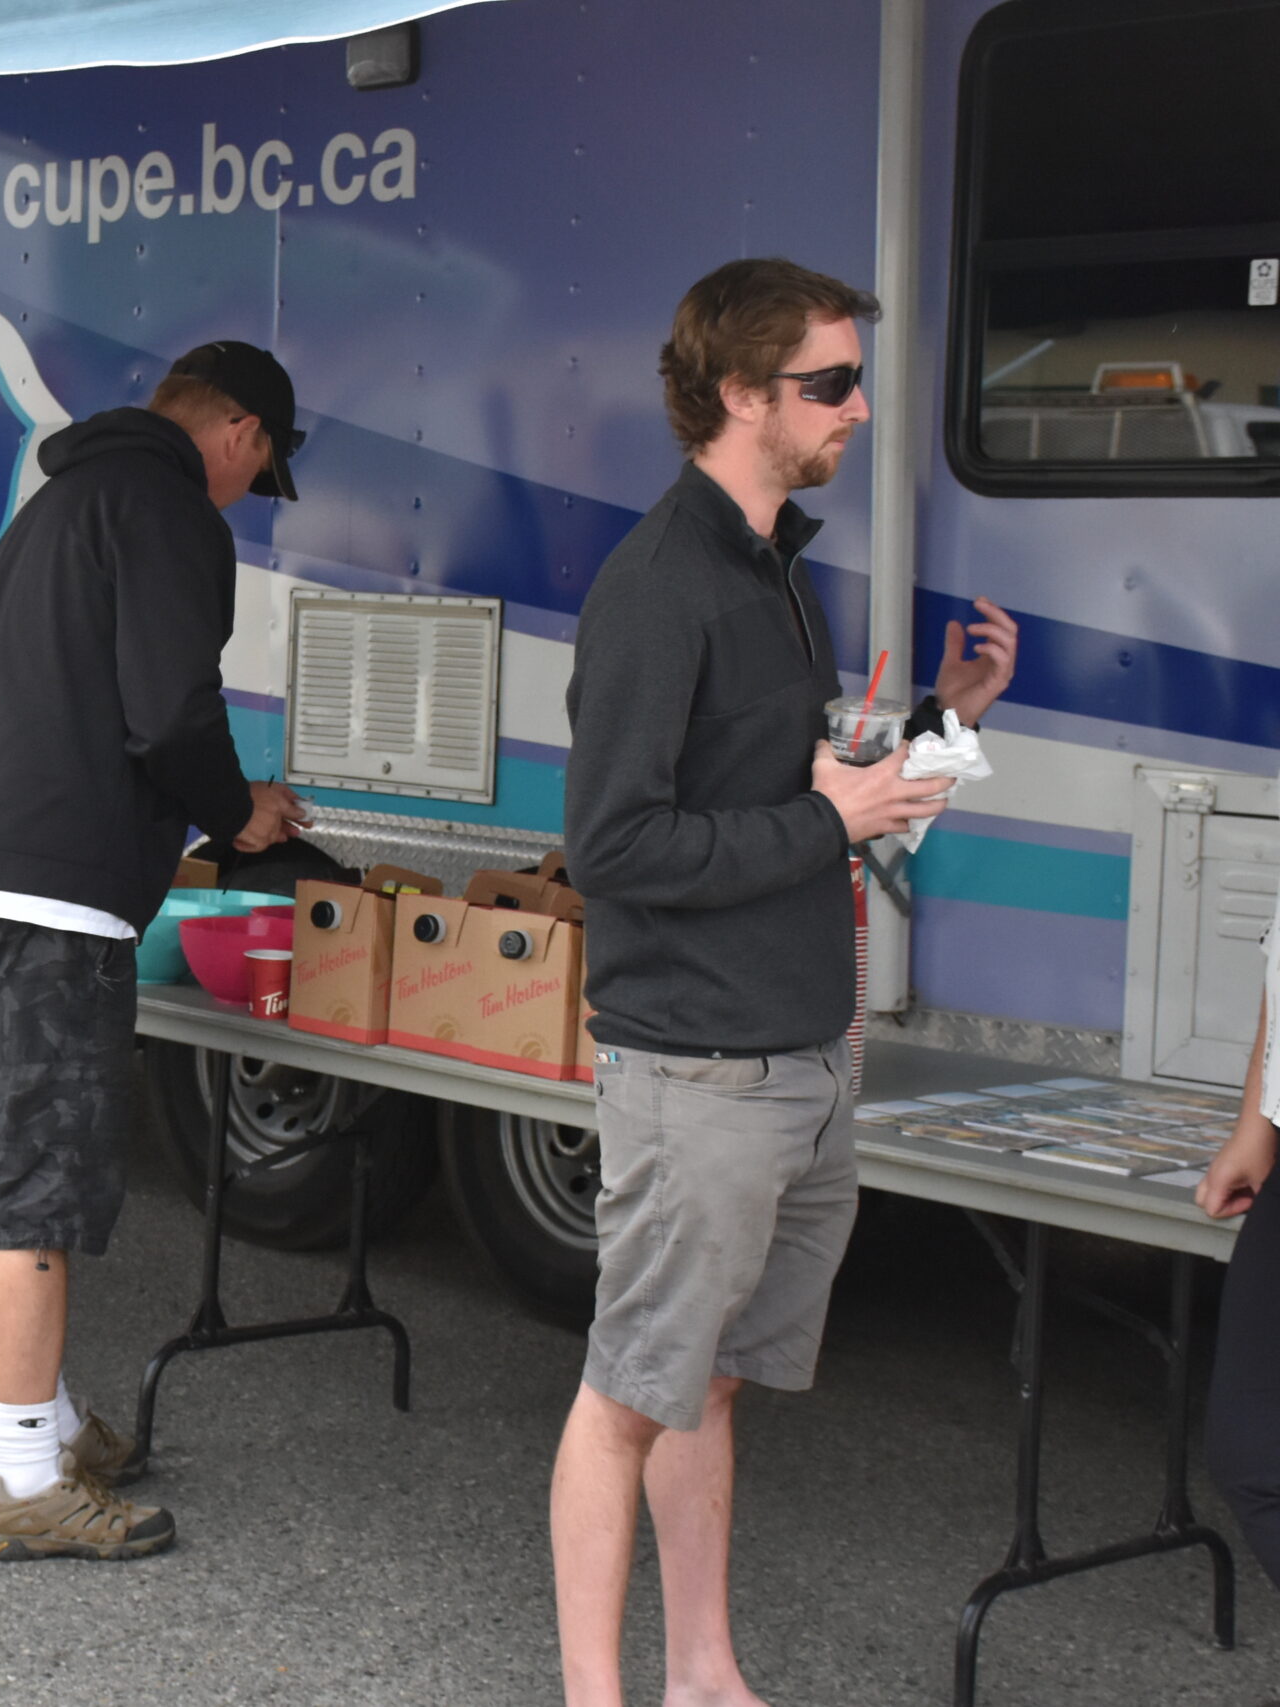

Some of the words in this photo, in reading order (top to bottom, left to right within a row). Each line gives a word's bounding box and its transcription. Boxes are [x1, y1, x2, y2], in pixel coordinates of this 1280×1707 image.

[3, 123, 416, 243] cupe.bc.ca
[396, 975, 419, 1001] Tim
[421, 961, 473, 990] Hortons
[477, 992, 504, 1019] Tim
[506, 978, 561, 1008] Hortons
